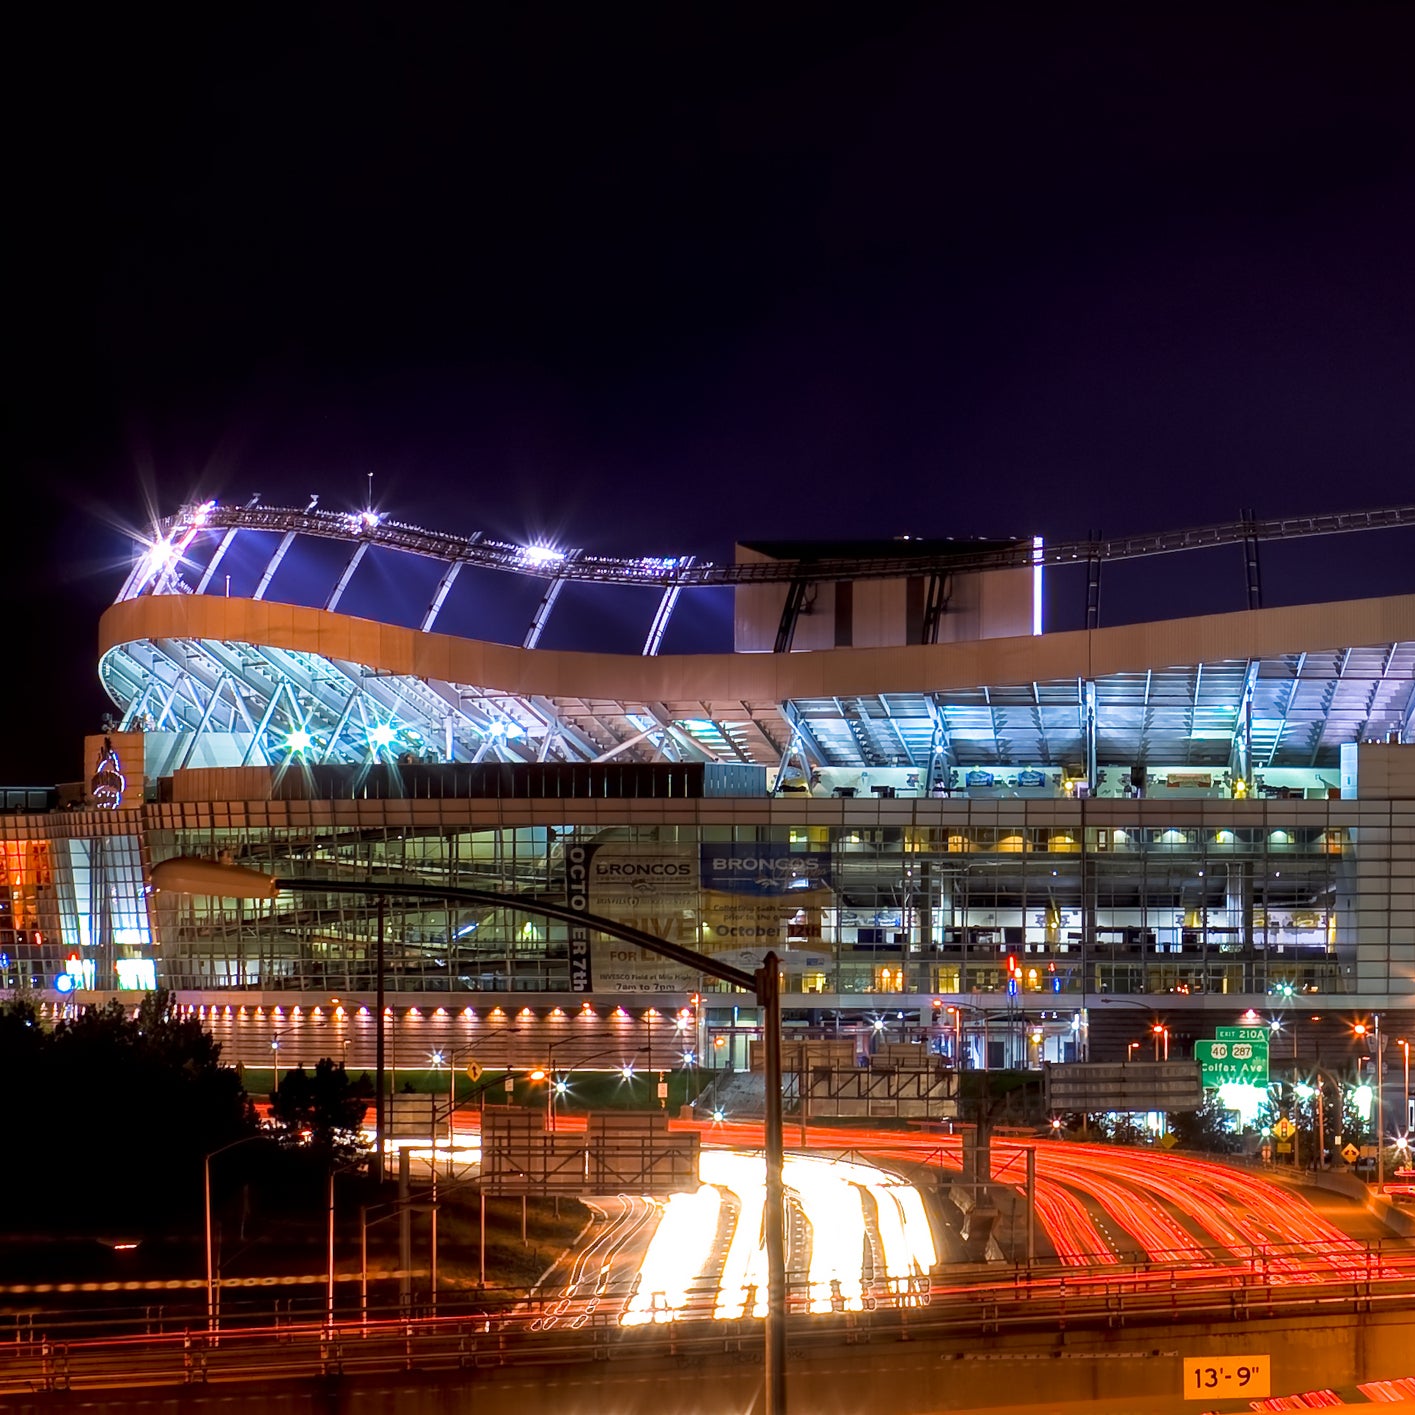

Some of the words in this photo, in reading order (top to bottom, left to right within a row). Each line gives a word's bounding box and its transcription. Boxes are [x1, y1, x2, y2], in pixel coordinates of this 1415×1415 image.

[596, 863, 691, 875] BRONCOS
[712, 857, 819, 871] BRONCOS
[570, 847, 587, 955] OCTOER
[716, 925, 780, 937] October
[610, 951, 637, 962] FOR
[572, 958, 588, 992] 7th
[654, 983, 675, 991] 7pm
[1239, 1030, 1265, 1039] 210A
[1212, 1047, 1226, 1056] 40
[1233, 1047, 1251, 1056] 287
[1202, 1063, 1237, 1072] Colfax
[1241, 1063, 1263, 1072] Ave
